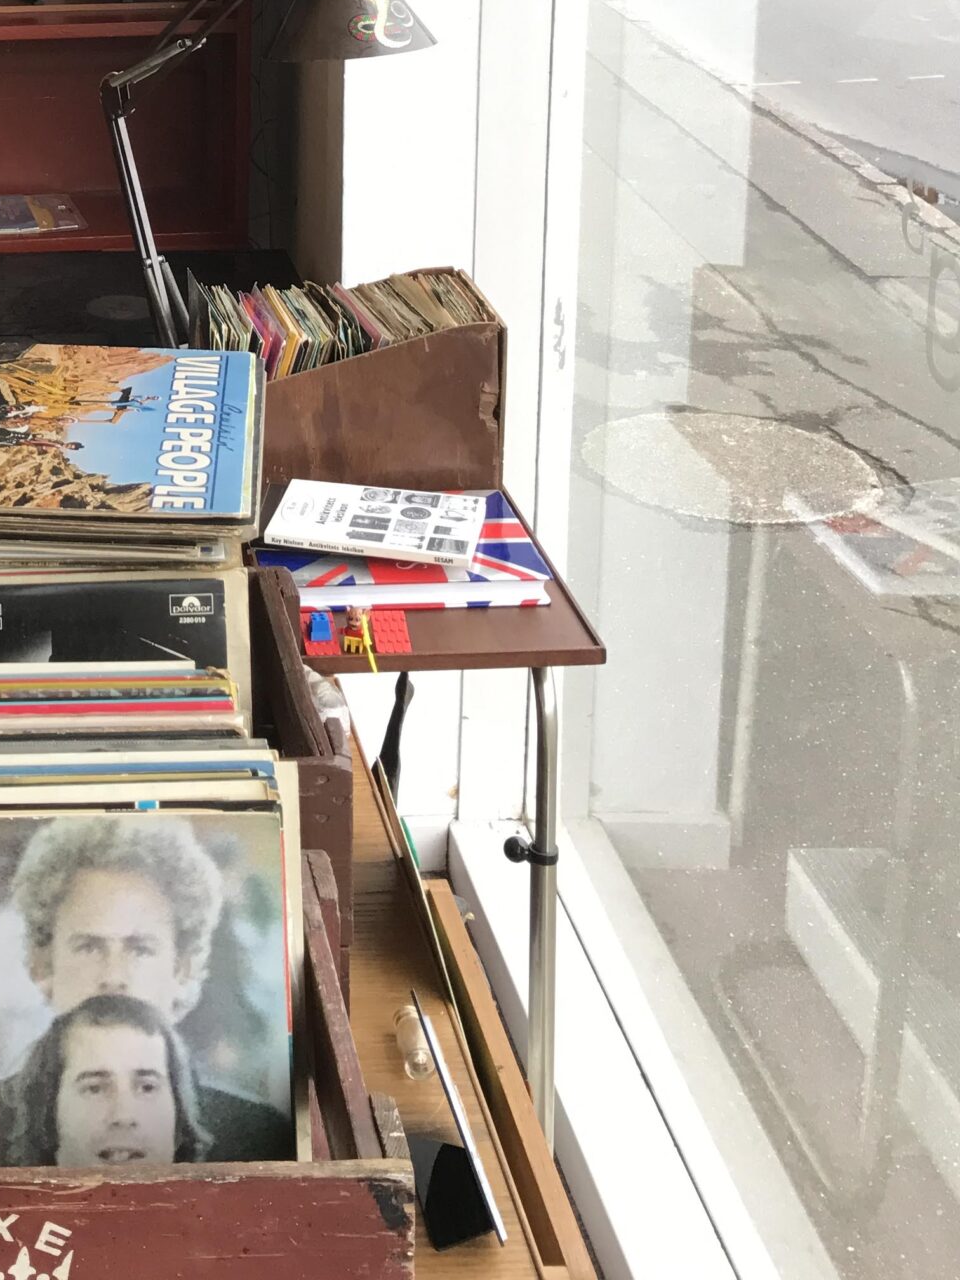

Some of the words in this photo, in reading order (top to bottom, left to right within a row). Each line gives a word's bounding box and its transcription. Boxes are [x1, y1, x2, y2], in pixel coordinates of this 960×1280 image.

[166, 355, 222, 425] VILLAGE
[152, 427, 214, 510] PEOPLE
[433, 556, 454, 565] SESAM
